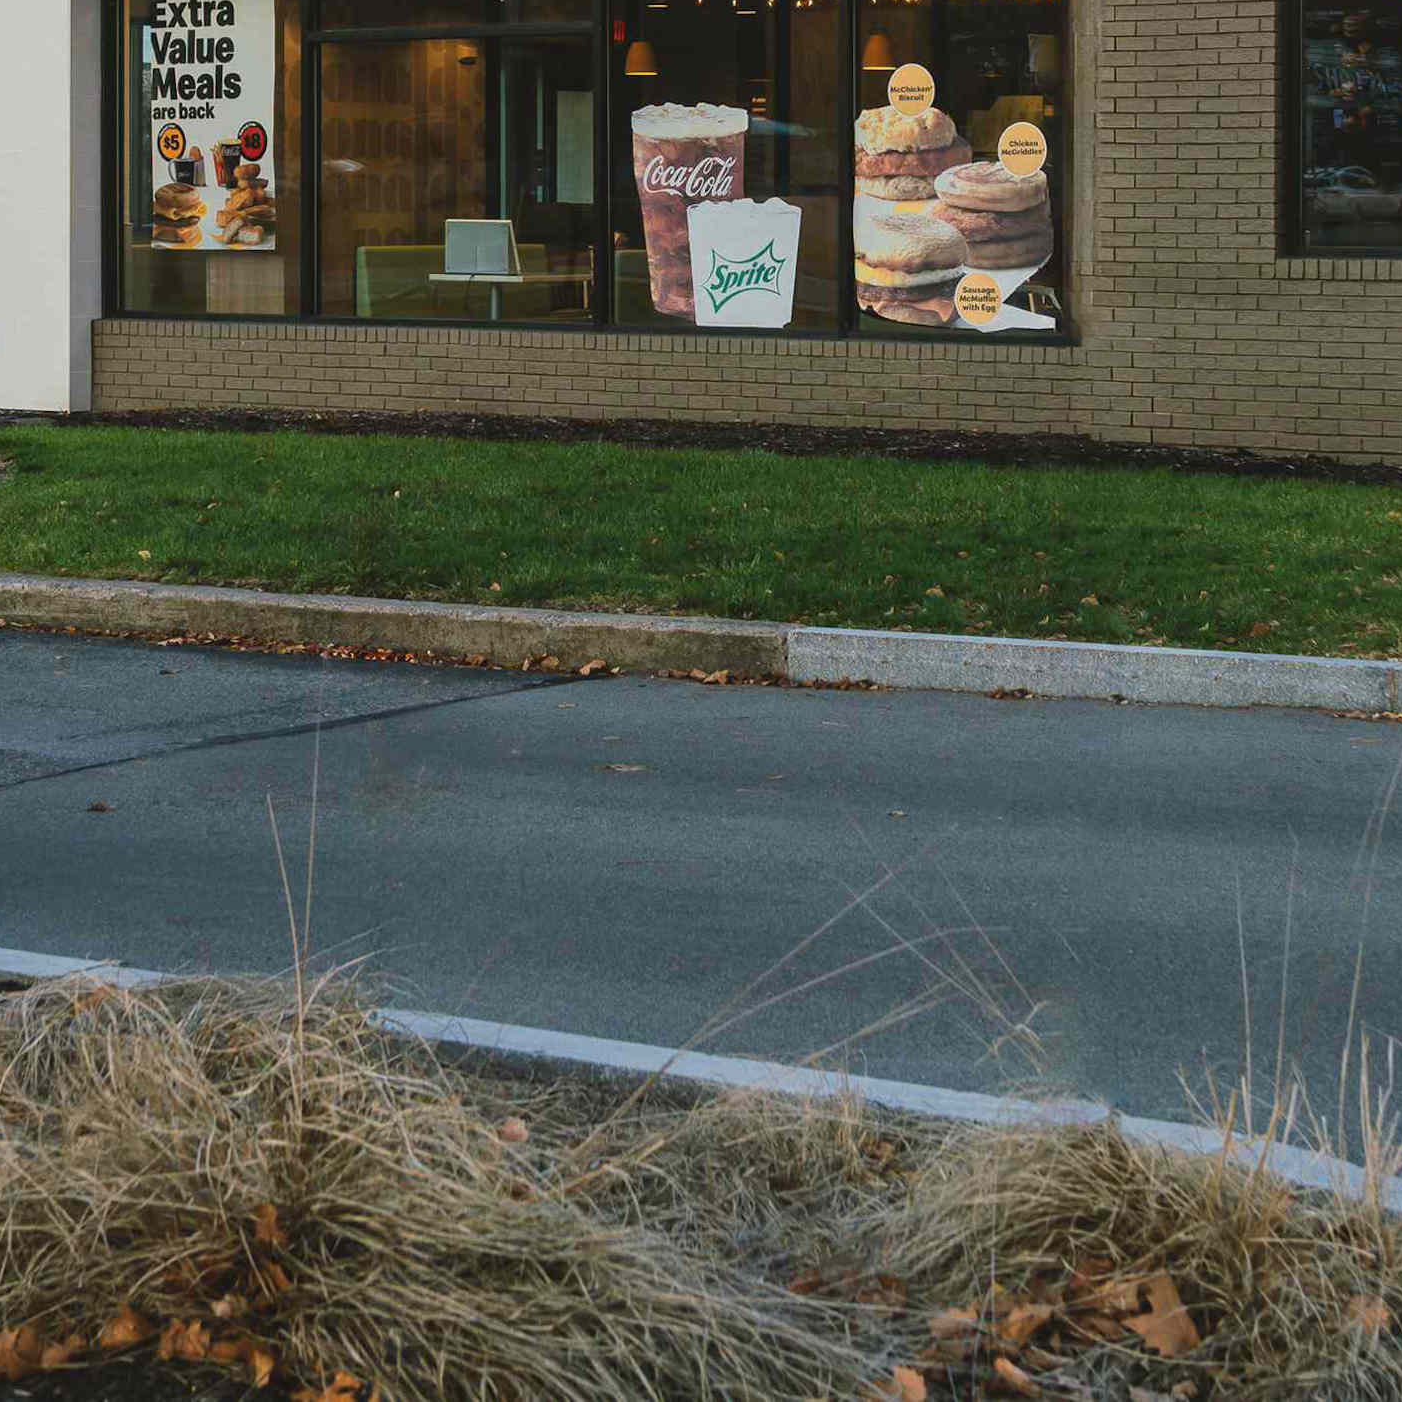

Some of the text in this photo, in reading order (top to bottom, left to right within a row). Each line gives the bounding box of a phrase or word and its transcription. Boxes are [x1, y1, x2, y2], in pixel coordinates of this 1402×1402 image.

[151, 30, 234, 64] Value
[151, 64, 241, 100] Meals
[153, 102, 215, 119] are back
[643, 155, 736, 197] Coca-Cola
[710, 262, 777, 293] Sprite
